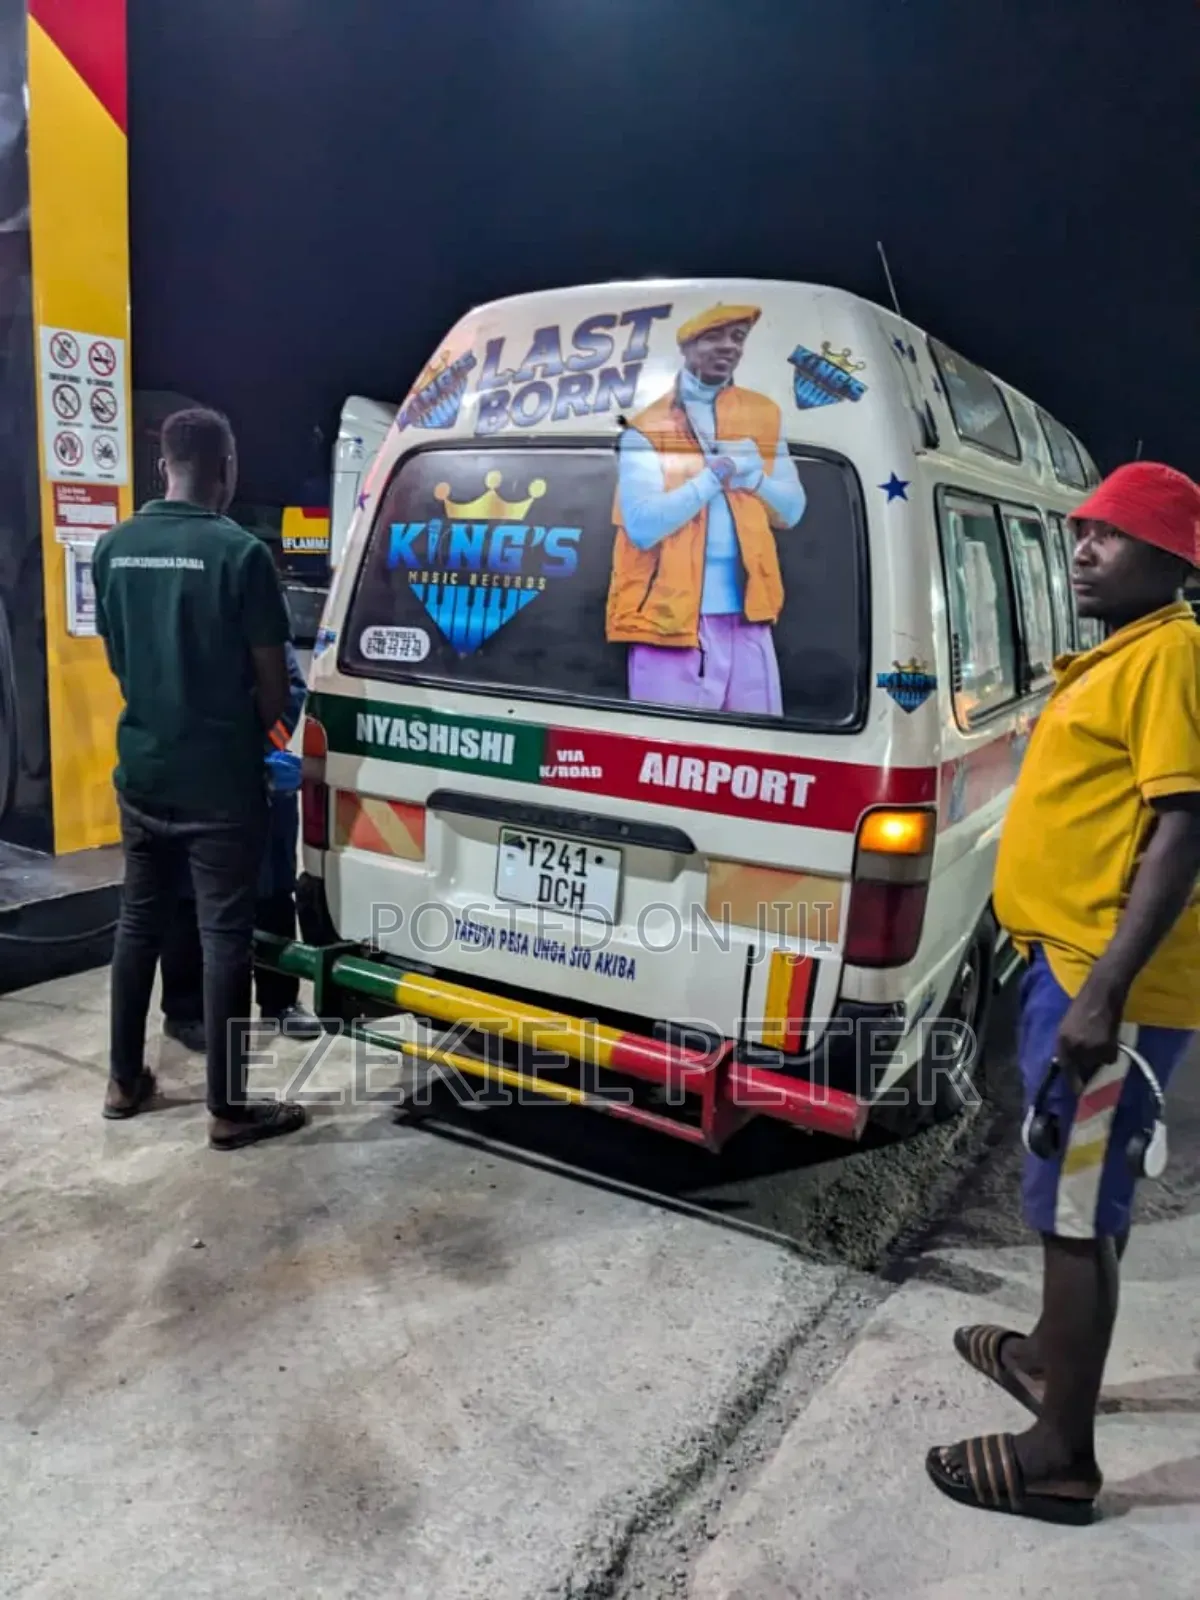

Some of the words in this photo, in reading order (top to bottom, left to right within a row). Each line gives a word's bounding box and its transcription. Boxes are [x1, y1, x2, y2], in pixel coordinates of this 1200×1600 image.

[476, 303, 673, 392] LAST
[473, 362, 643, 437] BORN
[387, 518, 583, 577] KING'S
[408, 571, 458, 585] MUSIC
[469, 572, 547, 590] RECORDS
[356, 712, 516, 766] NYASHISHI
[556, 749, 585, 763] VIA
[539, 765, 603, 779] K/ROAD
[638, 751, 817, 809] AIRPORT
[525, 836, 588, 878] T241
[537, 873, 586, 913] DCH
[454, 918, 495, 949] TAFUTA
[499, 929, 529, 957] PESA
[533, 935, 566, 967] UNGA
[569, 946, 591, 970] SIO
[595, 952, 636, 981] AKIBA
